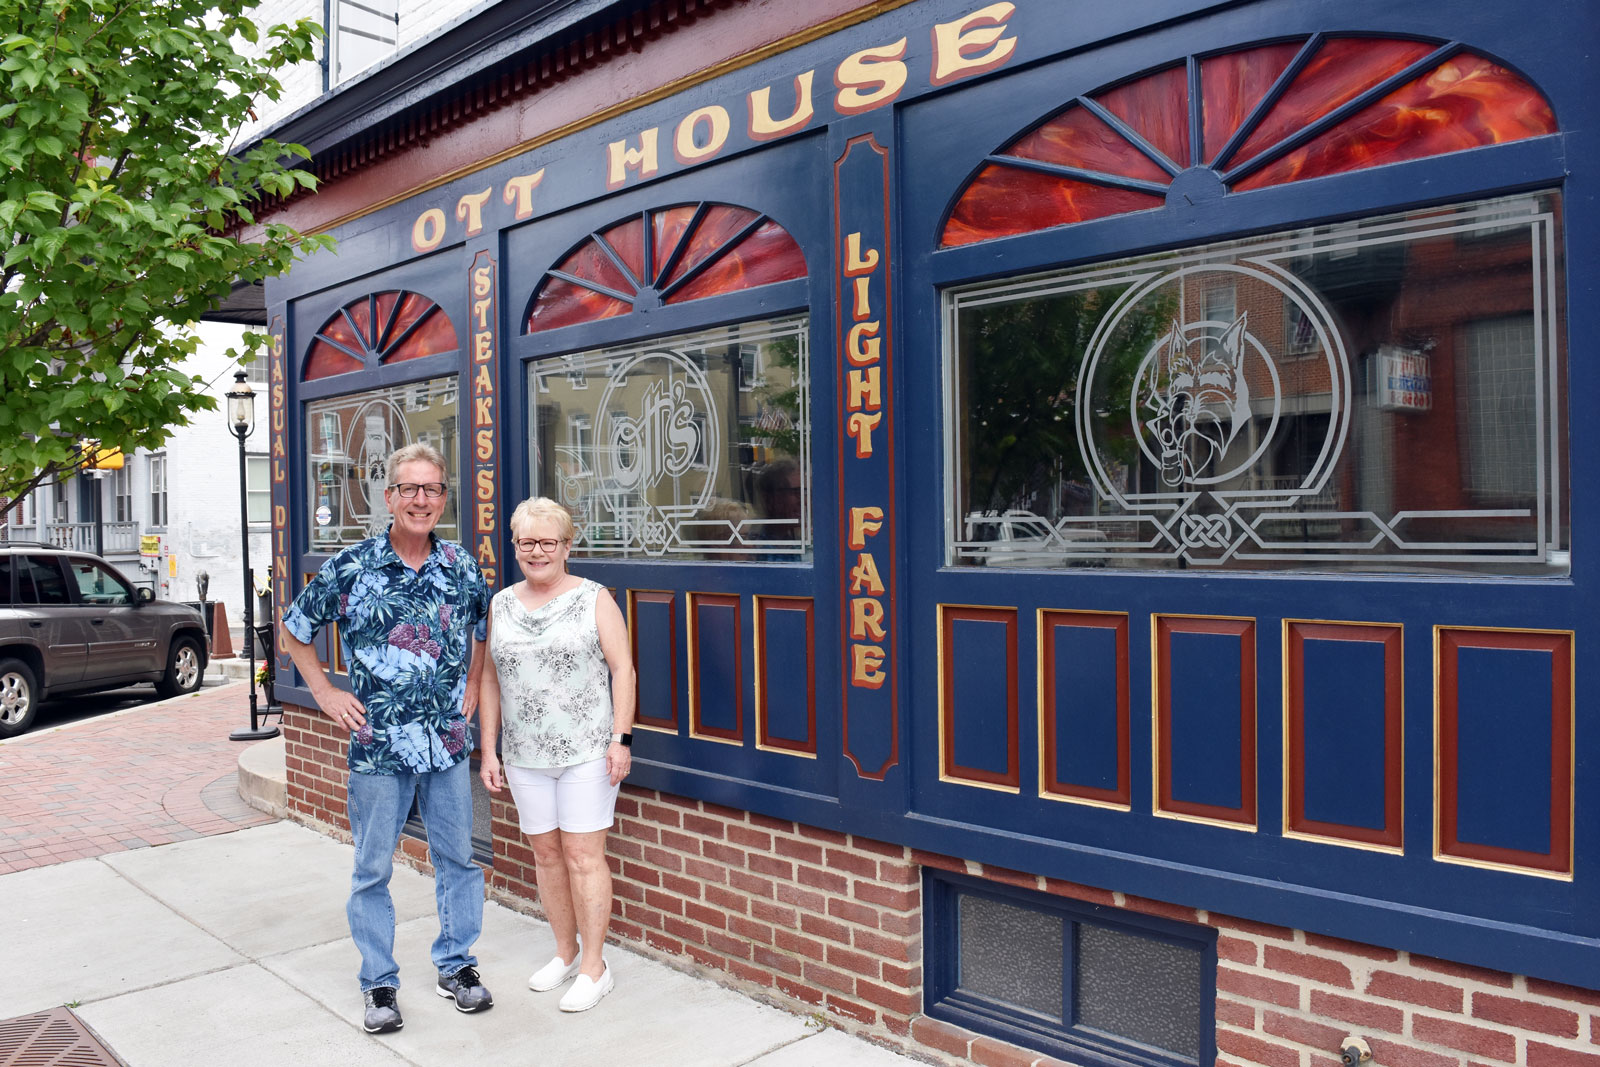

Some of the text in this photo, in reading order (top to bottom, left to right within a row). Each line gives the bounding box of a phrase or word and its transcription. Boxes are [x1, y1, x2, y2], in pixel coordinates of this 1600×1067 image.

[412, 1, 1018, 253] OTT HOUSE
[273, 333, 286, 484] CASUAL
[474, 265, 494, 462] STEAKS
[844, 232, 887, 690] LIGHT FARE
